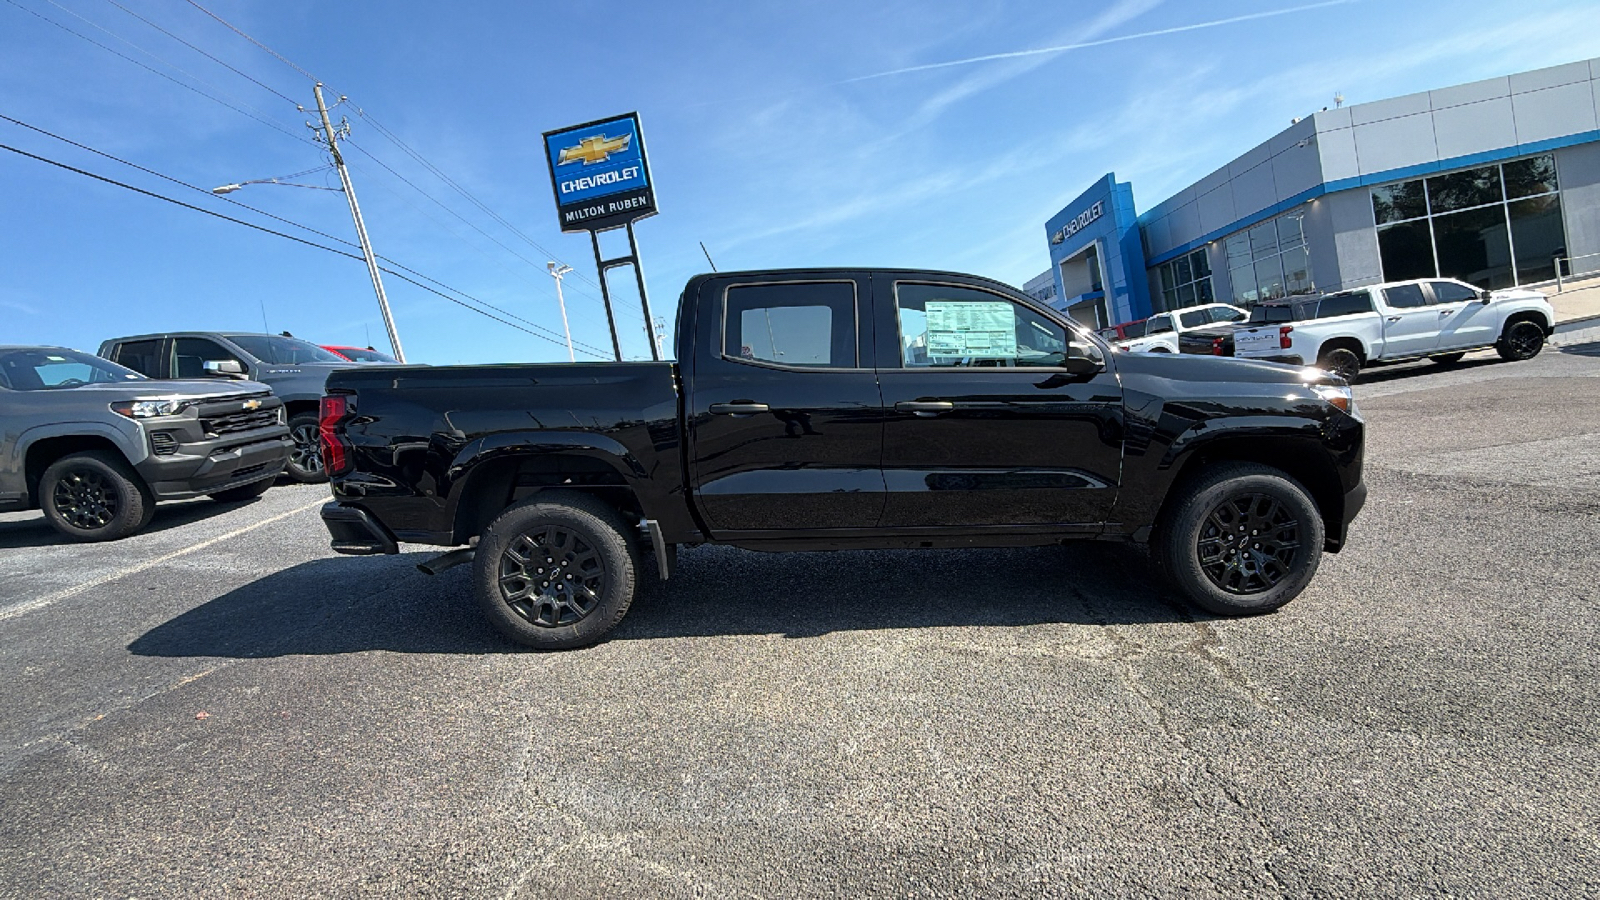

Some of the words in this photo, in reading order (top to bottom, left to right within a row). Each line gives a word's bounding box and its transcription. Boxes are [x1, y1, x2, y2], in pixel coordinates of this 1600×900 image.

[561, 166, 639, 194] CHEVROLET
[565, 204, 606, 222] MILTON
[609, 195, 647, 213] RUBEN
[1062, 200, 1104, 239] CHEVROLET
